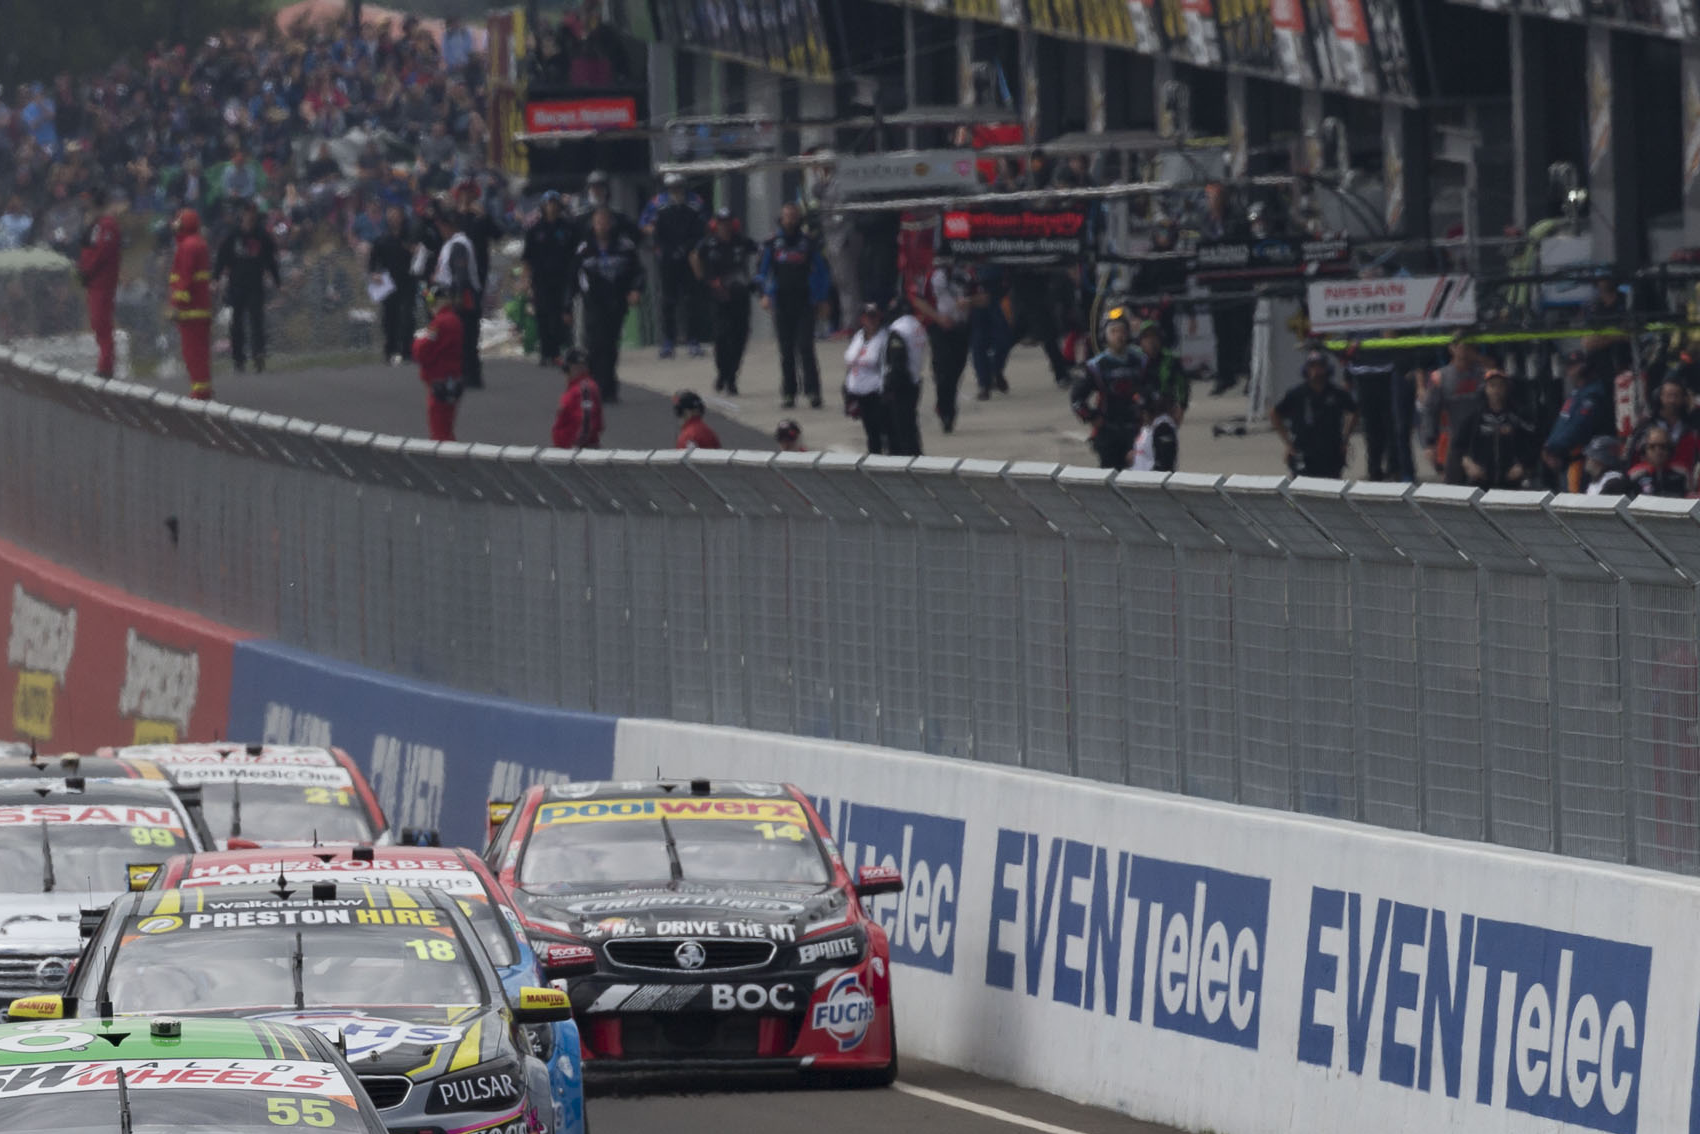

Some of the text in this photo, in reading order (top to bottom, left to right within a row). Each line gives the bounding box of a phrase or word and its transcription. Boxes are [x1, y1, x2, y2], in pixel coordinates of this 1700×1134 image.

[304, 787, 350, 806] 21
[540, 801, 800, 824] poolwerx
[128, 826, 176, 847] 99
[754, 823, 805, 842] 14
[353, 875, 473, 889] Storage
[209, 898, 364, 910] walkinshaw
[189, 909, 441, 929] PRESTON HIRE
[657, 920, 720, 936] DRIVE
[724, 921, 765, 938] THE
[769, 924, 796, 942] NT
[405, 939, 457, 962] 18
[799, 937, 857, 965] BIANTE
[711, 983, 795, 1011] BOC
[1298, 886, 1638, 1116] EVENTelec
[812, 998, 874, 1028] FUCHS
[76, 1068, 338, 1090] WHEELS
[136, 1061, 343, 1076] ALLOY
[439, 1074, 519, 1106] PULSAR
[266, 1097, 337, 1128] 55
